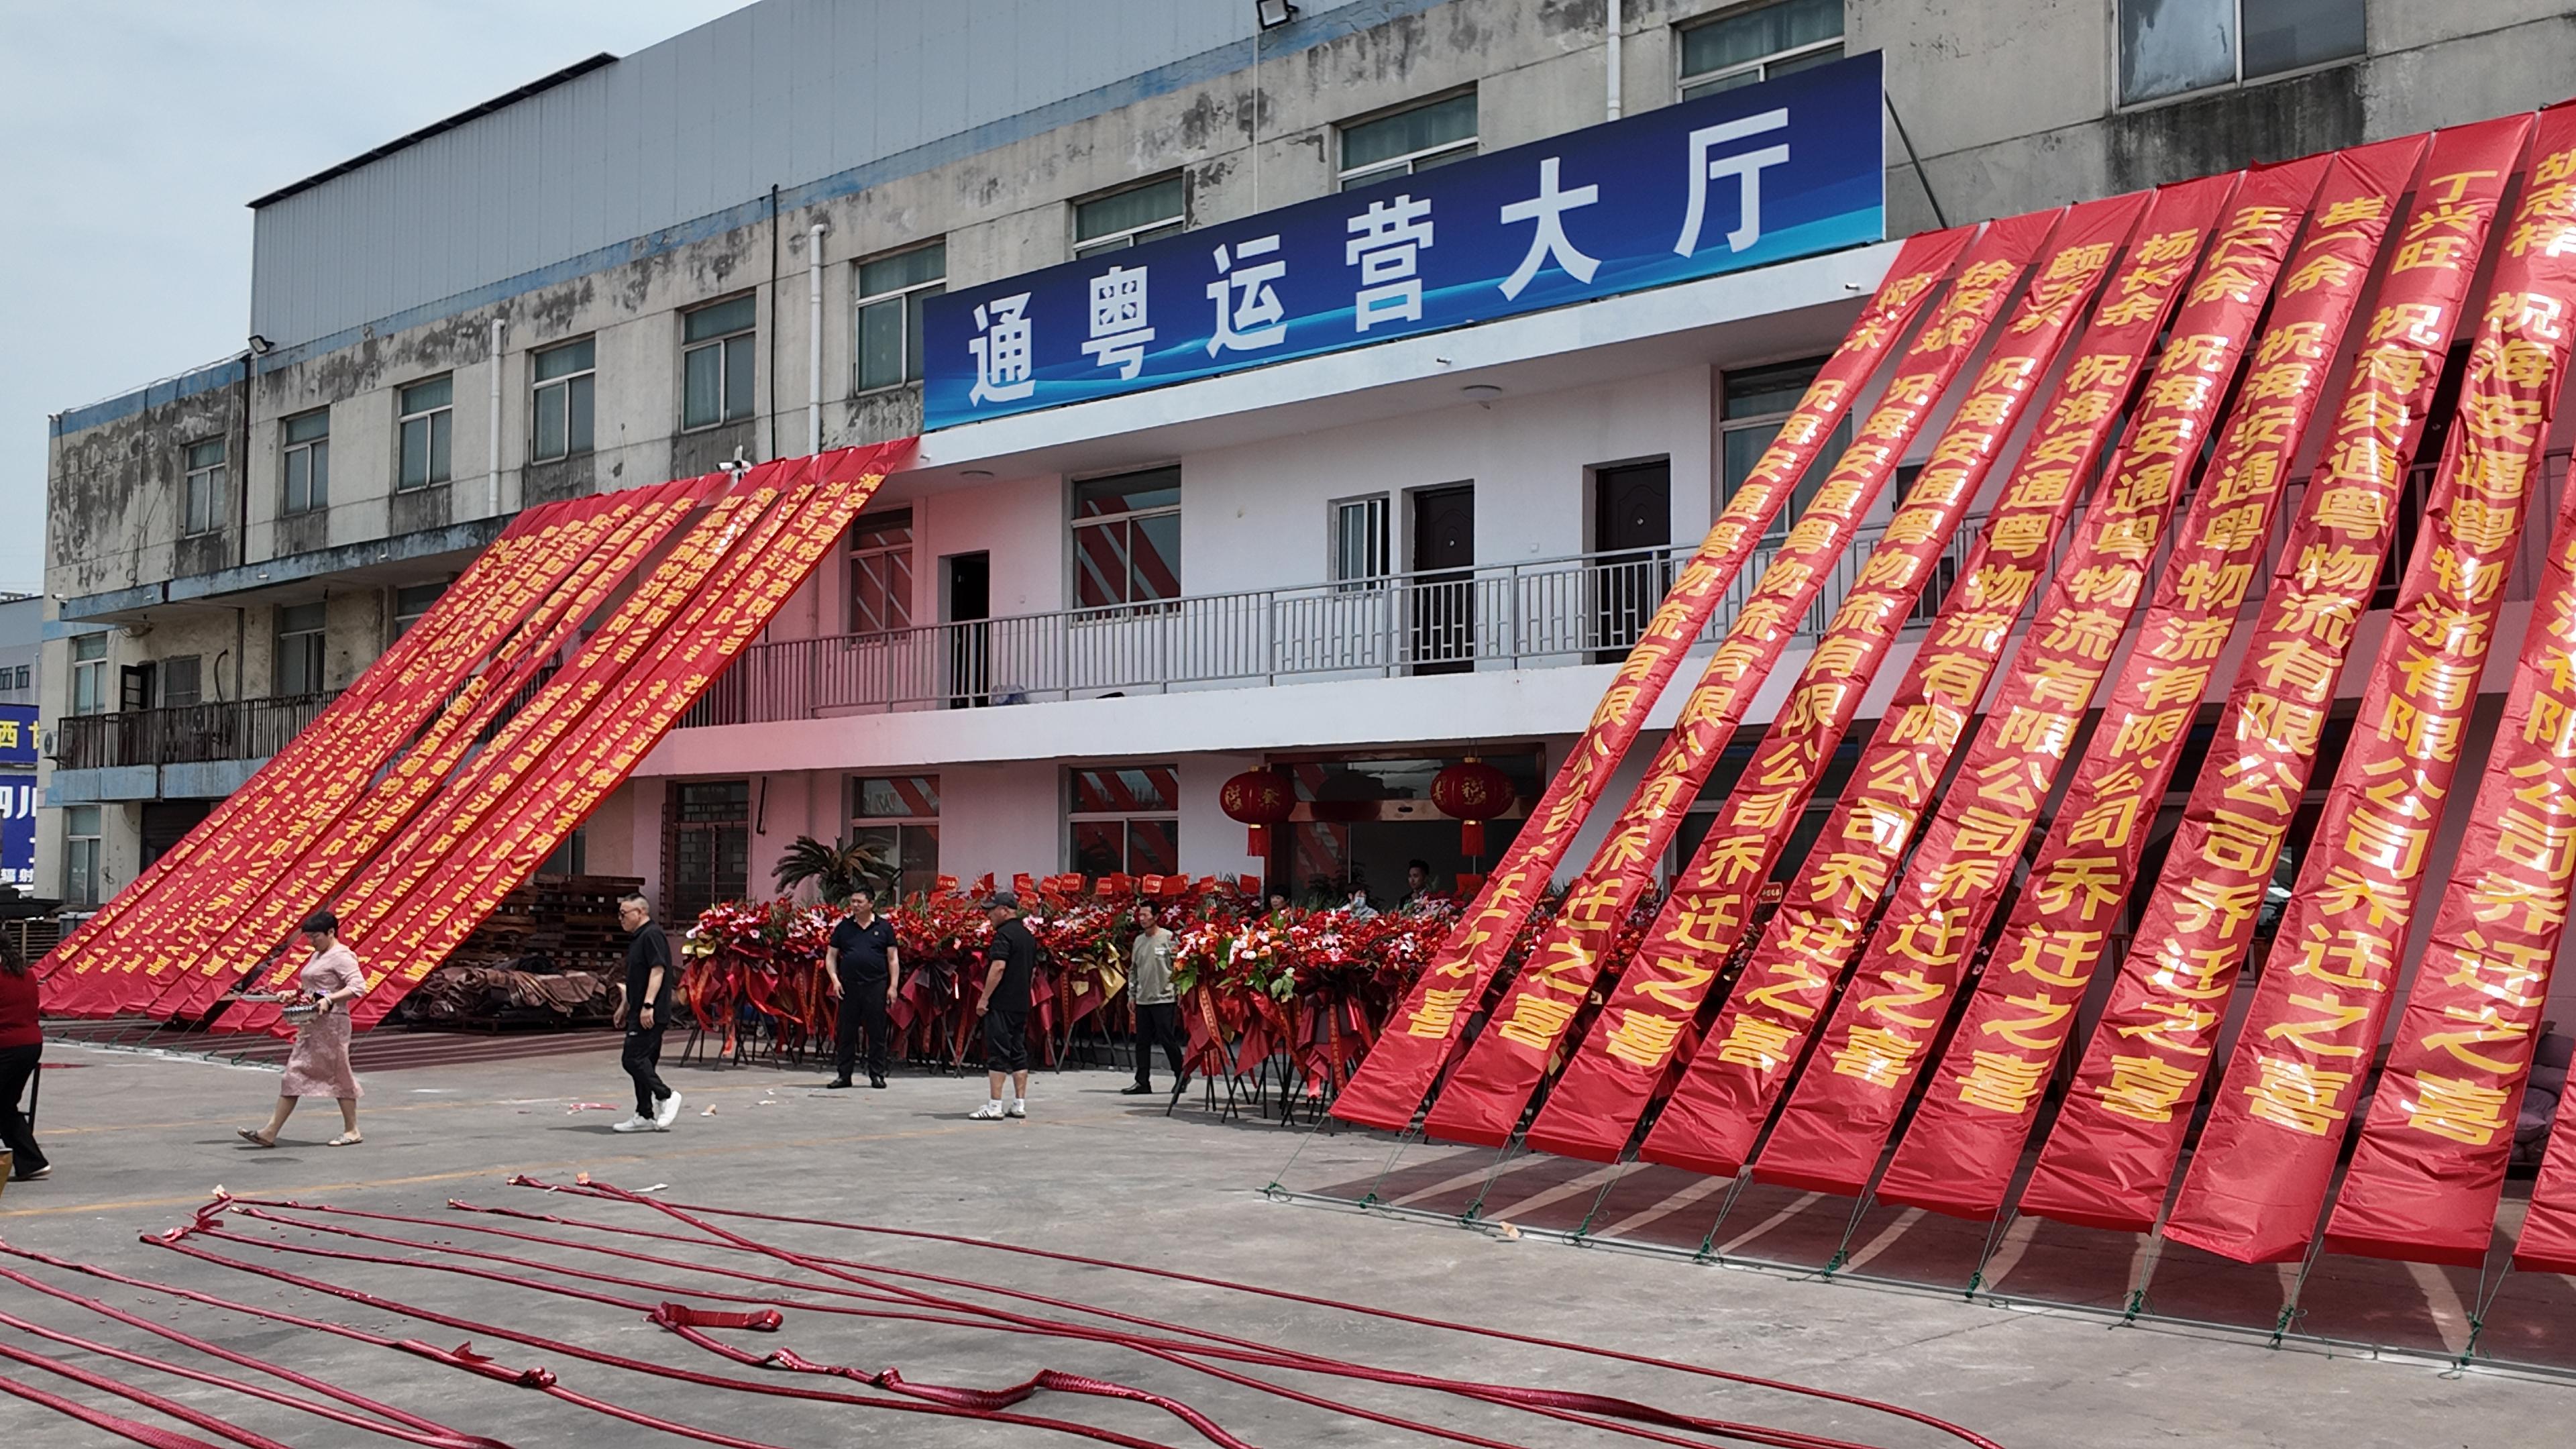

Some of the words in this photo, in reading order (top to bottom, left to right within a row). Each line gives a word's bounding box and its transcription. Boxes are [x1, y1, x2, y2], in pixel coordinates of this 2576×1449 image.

[969, 107, 1790, 407] 通粤运营大厅
[2096, 227, 2199, 327] 杨长余
[2188, 205, 2292, 308] 王仁余
[2282, 195, 2387, 299] 崔一余
[2392, 170, 2498, 276] 丁兴旺
[1719, 354, 2132, 1073] 祝海安通粤物流有限公司乔迁之喜
[1831, 335, 2229, 1089] 祝海安通粤物流有限公司乔迁之喜
[1956, 322, 2326, 1115] 祝海安通粤物流有限公司乔迁之喜
[2095, 304, 2442, 1123] 祝海安通粤物流有限公司乔迁之喜
[2243, 292, 2562, 1136] 祝海安通粤物流有限公司乔迁之喜
[2400, 540, 2576, 1146] 限公司乔迁之喜
